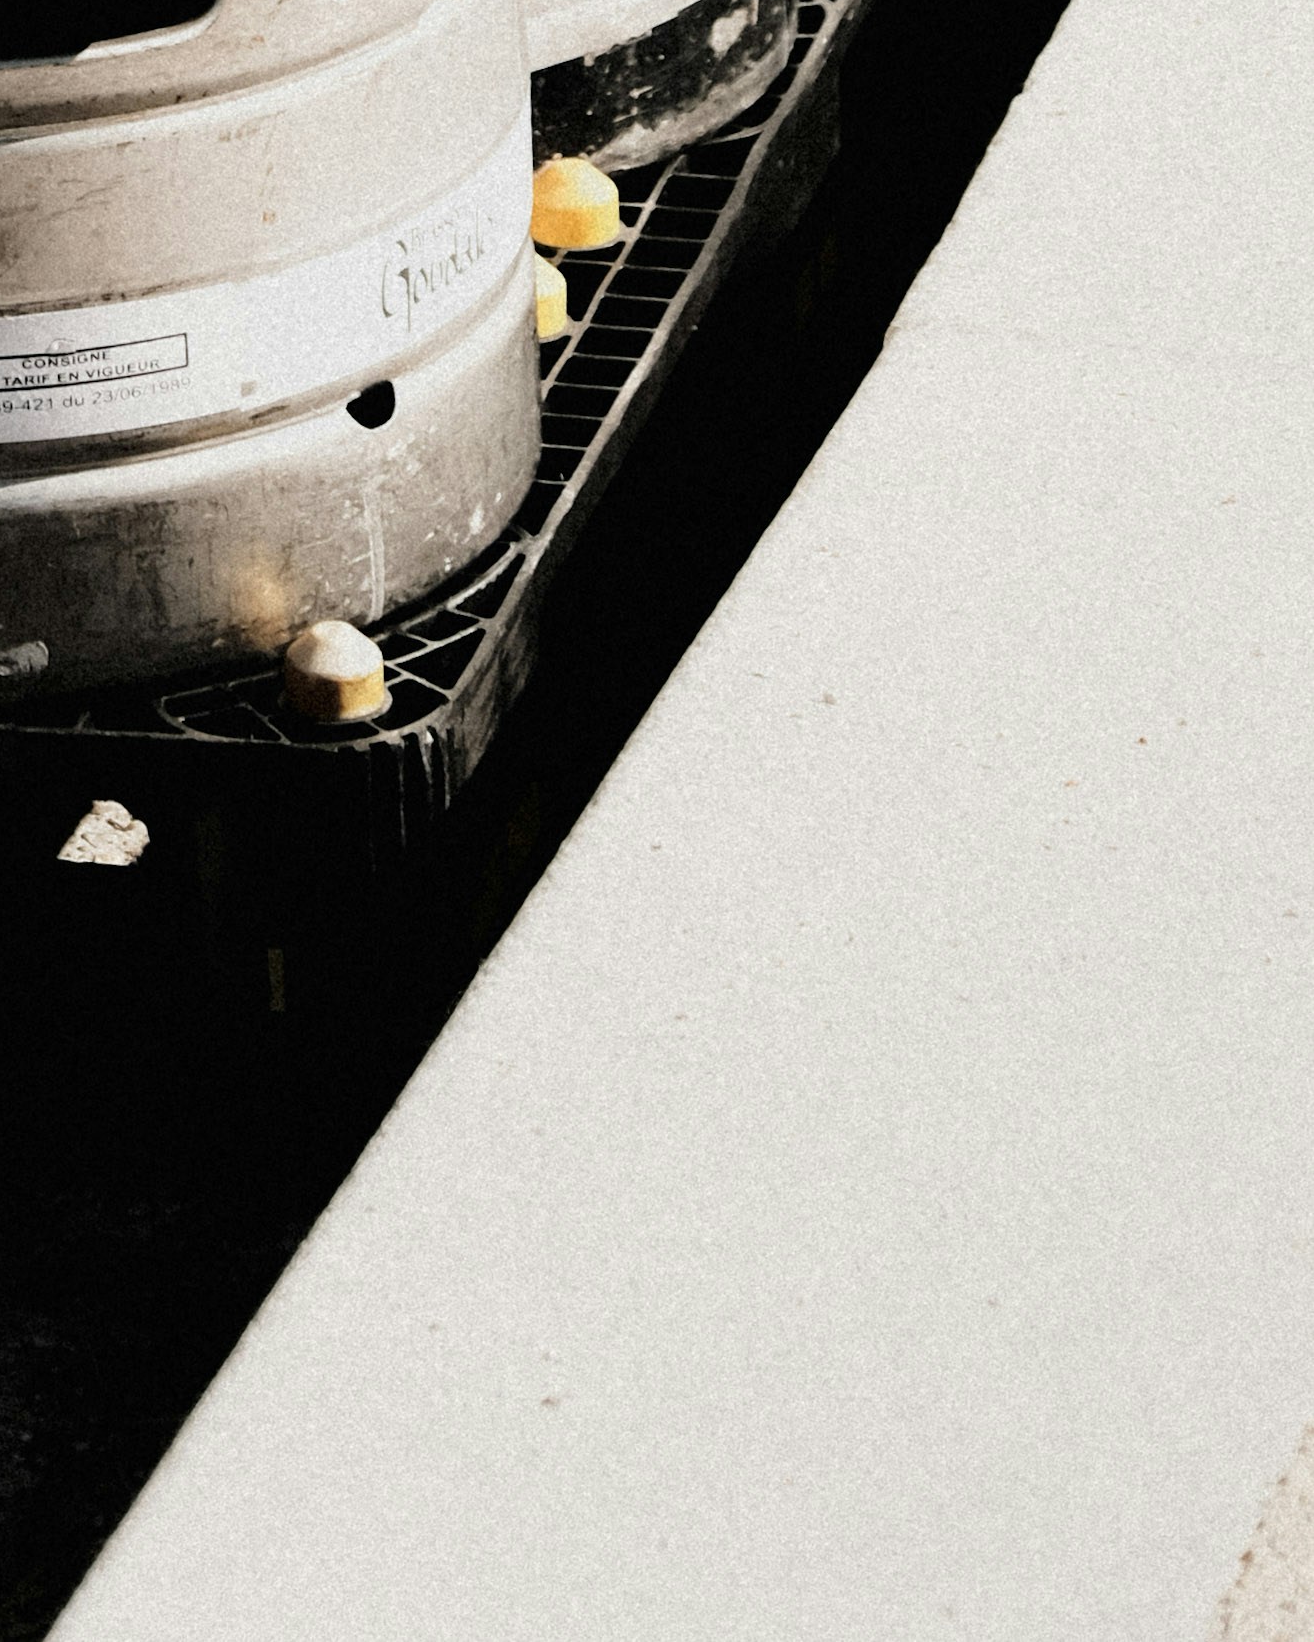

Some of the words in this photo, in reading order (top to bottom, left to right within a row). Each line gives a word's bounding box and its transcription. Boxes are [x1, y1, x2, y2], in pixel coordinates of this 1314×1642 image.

[22, 350, 110, 370] CONSIGNE
[2, 374, 50, 388] TARIF
[57, 371, 79, 384] EN
[84, 358, 161, 379] VIGUEUR
[62, 394, 85, 409] du
